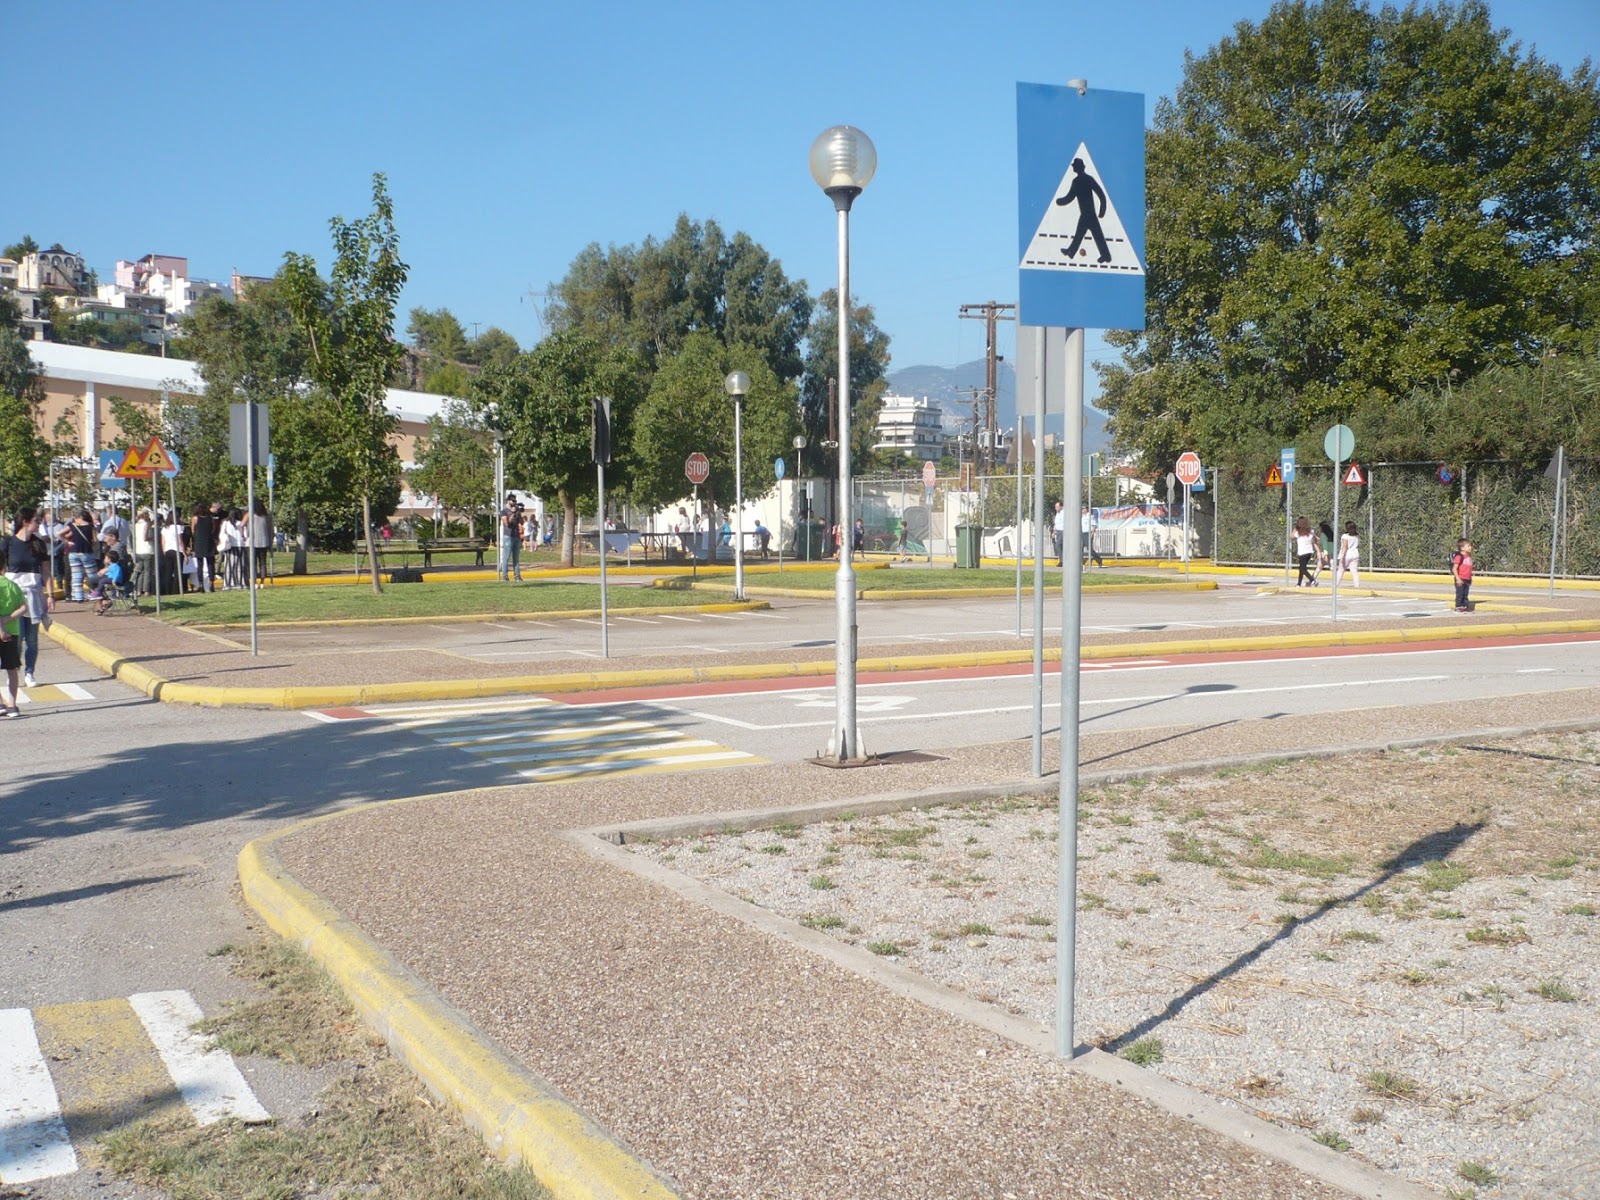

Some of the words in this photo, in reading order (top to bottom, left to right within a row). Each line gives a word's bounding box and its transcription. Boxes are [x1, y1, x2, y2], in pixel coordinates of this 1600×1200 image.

[687, 461, 708, 476] STOP
[1178, 460, 1199, 476] STOP
[1283, 462, 1292, 477] P
